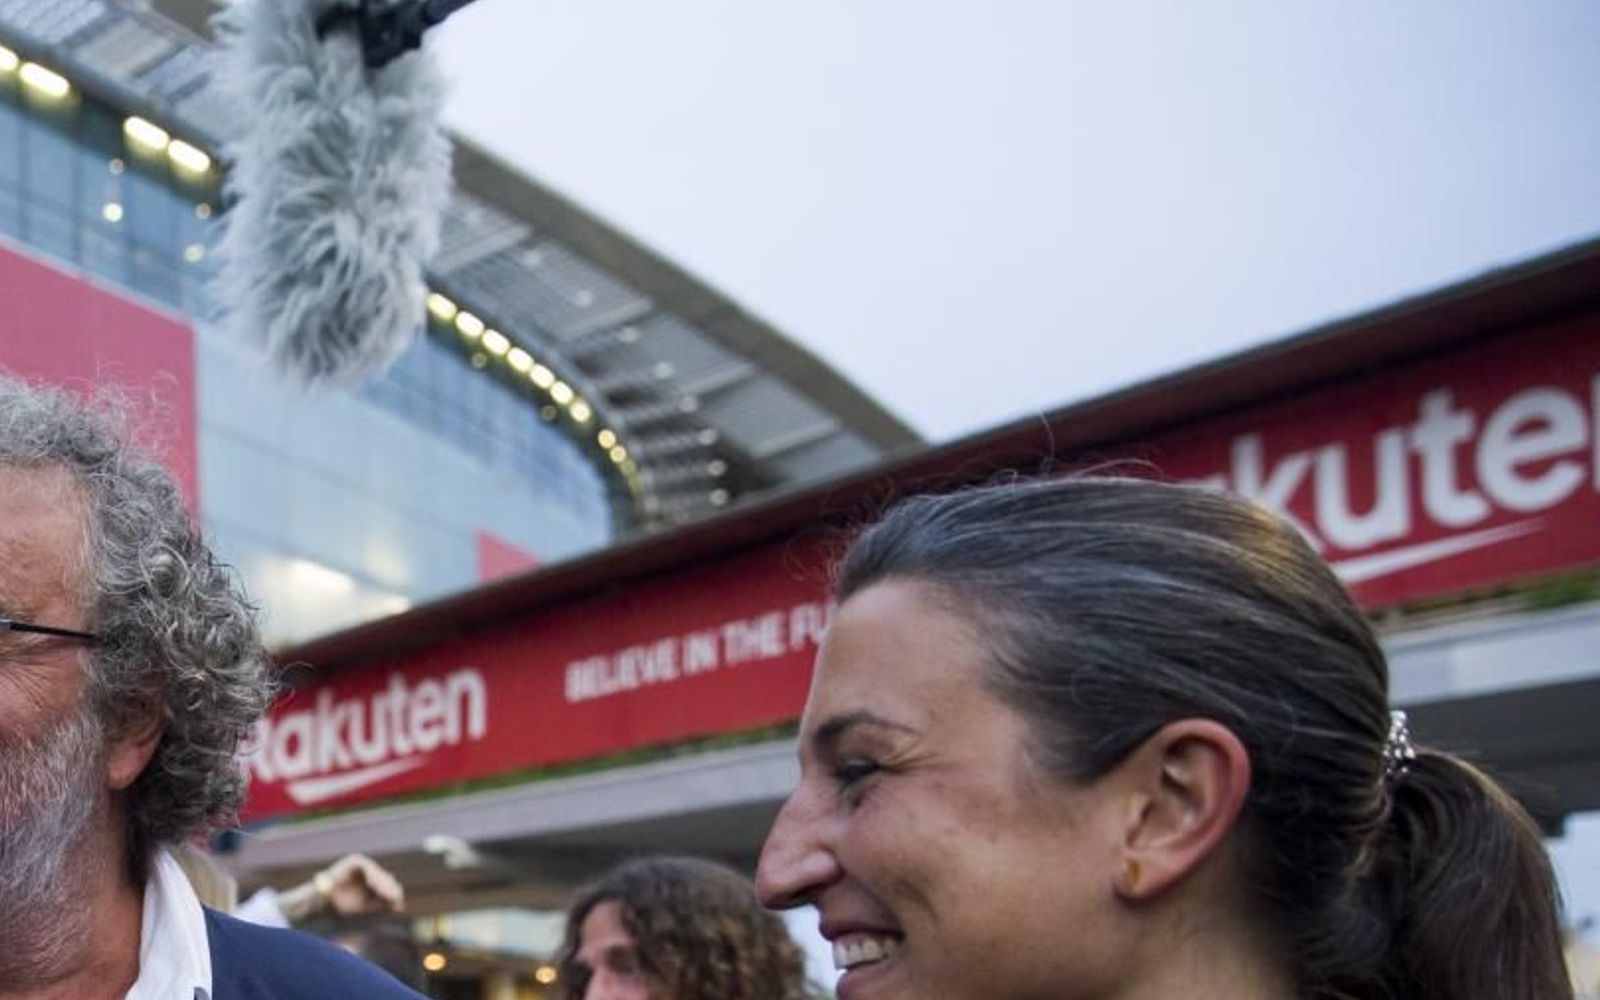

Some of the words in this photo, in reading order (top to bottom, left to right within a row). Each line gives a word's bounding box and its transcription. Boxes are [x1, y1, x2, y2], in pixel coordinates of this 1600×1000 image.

[1185, 373, 1600, 550] kute
[564, 636, 680, 703] BELIEVE
[683, 628, 718, 676] IN
[723, 611, 786, 666] THE
